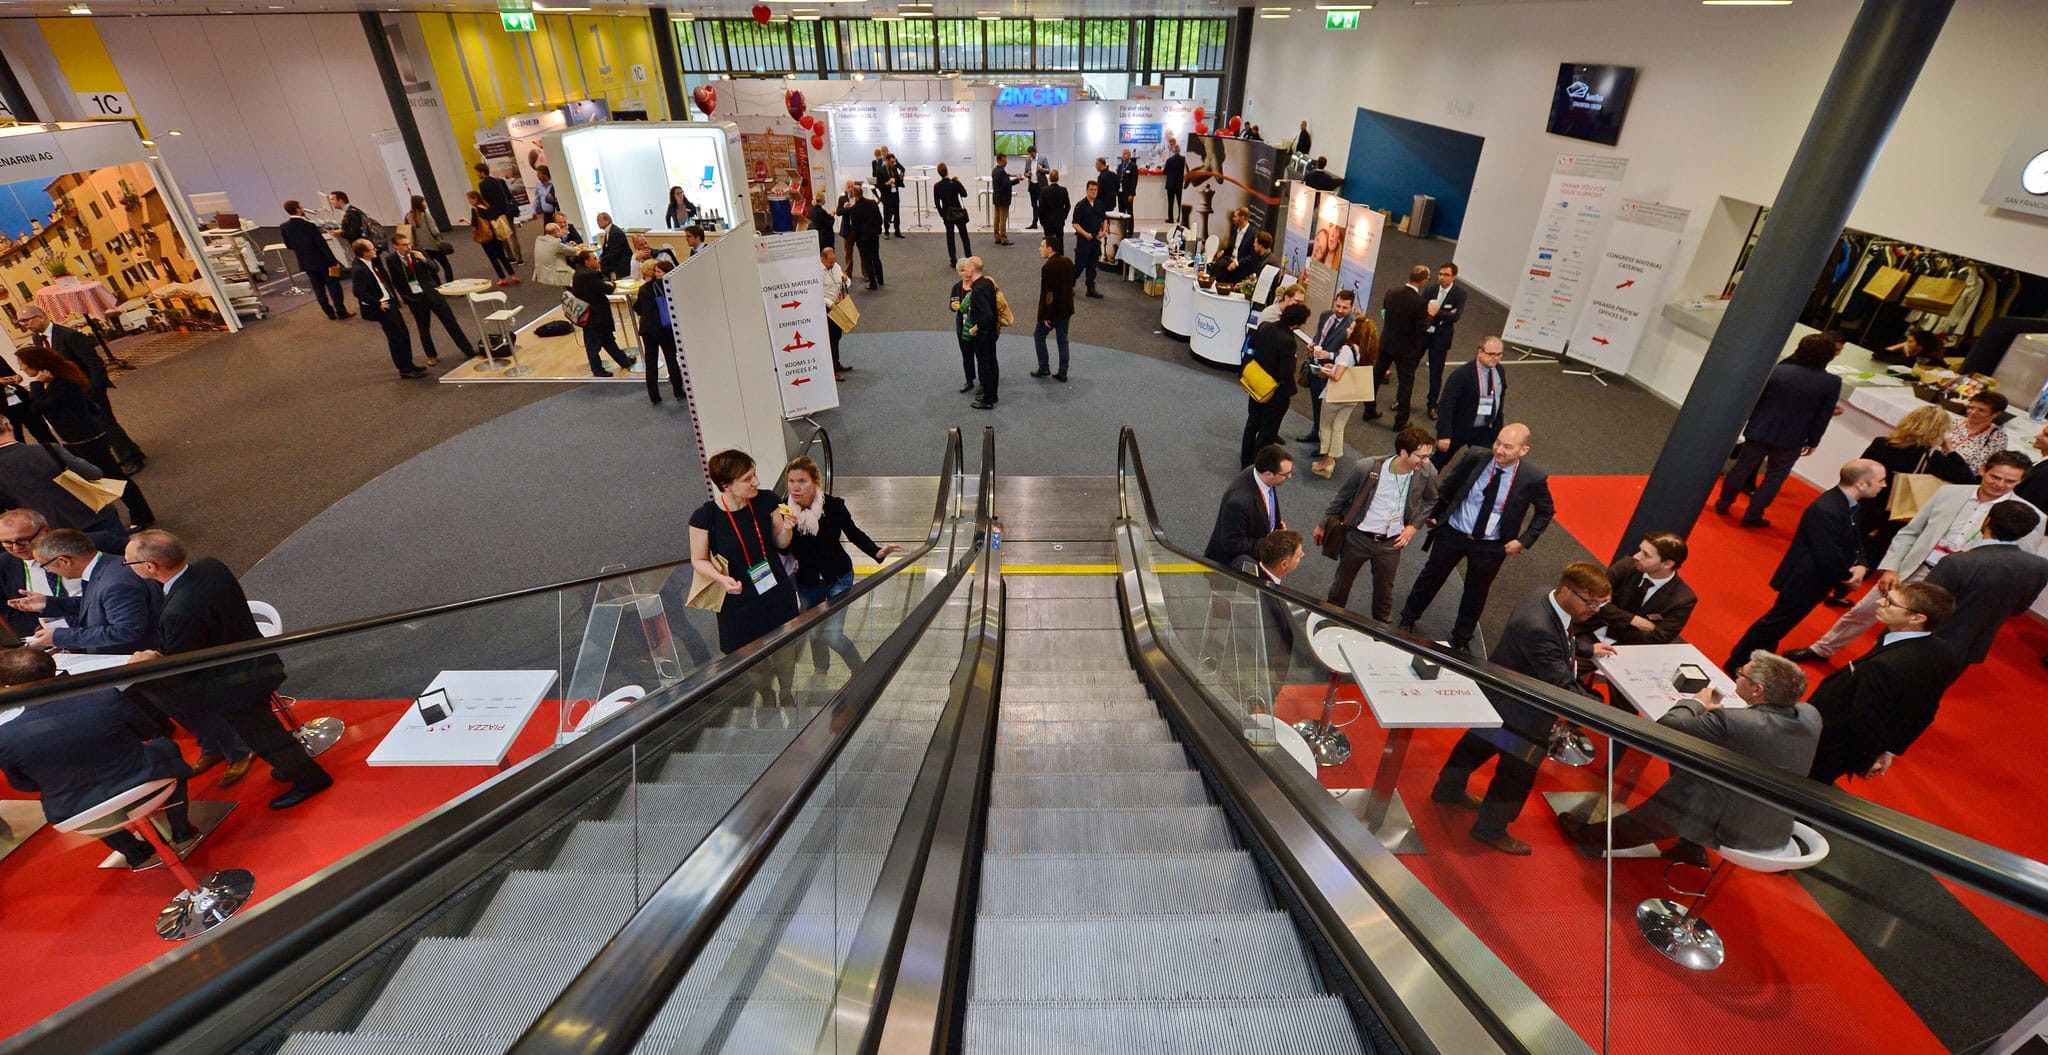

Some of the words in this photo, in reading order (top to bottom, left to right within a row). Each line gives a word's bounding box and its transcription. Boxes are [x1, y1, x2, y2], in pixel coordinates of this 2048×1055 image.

[997, 87, 1069, 107] AMGEN
[92, 95, 122, 114] 1C
[38, 152, 53, 161] AG
[1606, 251, 1634, 263] CONGRESS
[1636, 258, 1662, 270] MATERIAL
[1618, 262, 1643, 273] CATERING
[761, 283, 790, 292] ONGRESS
[791, 278, 819, 288] MATERIAL
[780, 288, 808, 298] CATERING
[1592, 299, 1615, 310] SPEAKER
[1616, 305, 1638, 317] PREVIEW
[1598, 308, 1619, 320] OFFICES
[779, 318, 811, 329] EXHIBITION
[785, 359, 806, 369] ROOMS
[785, 367, 807, 376] OFFICES
[1435, 688, 1472, 696] PIAZZA
